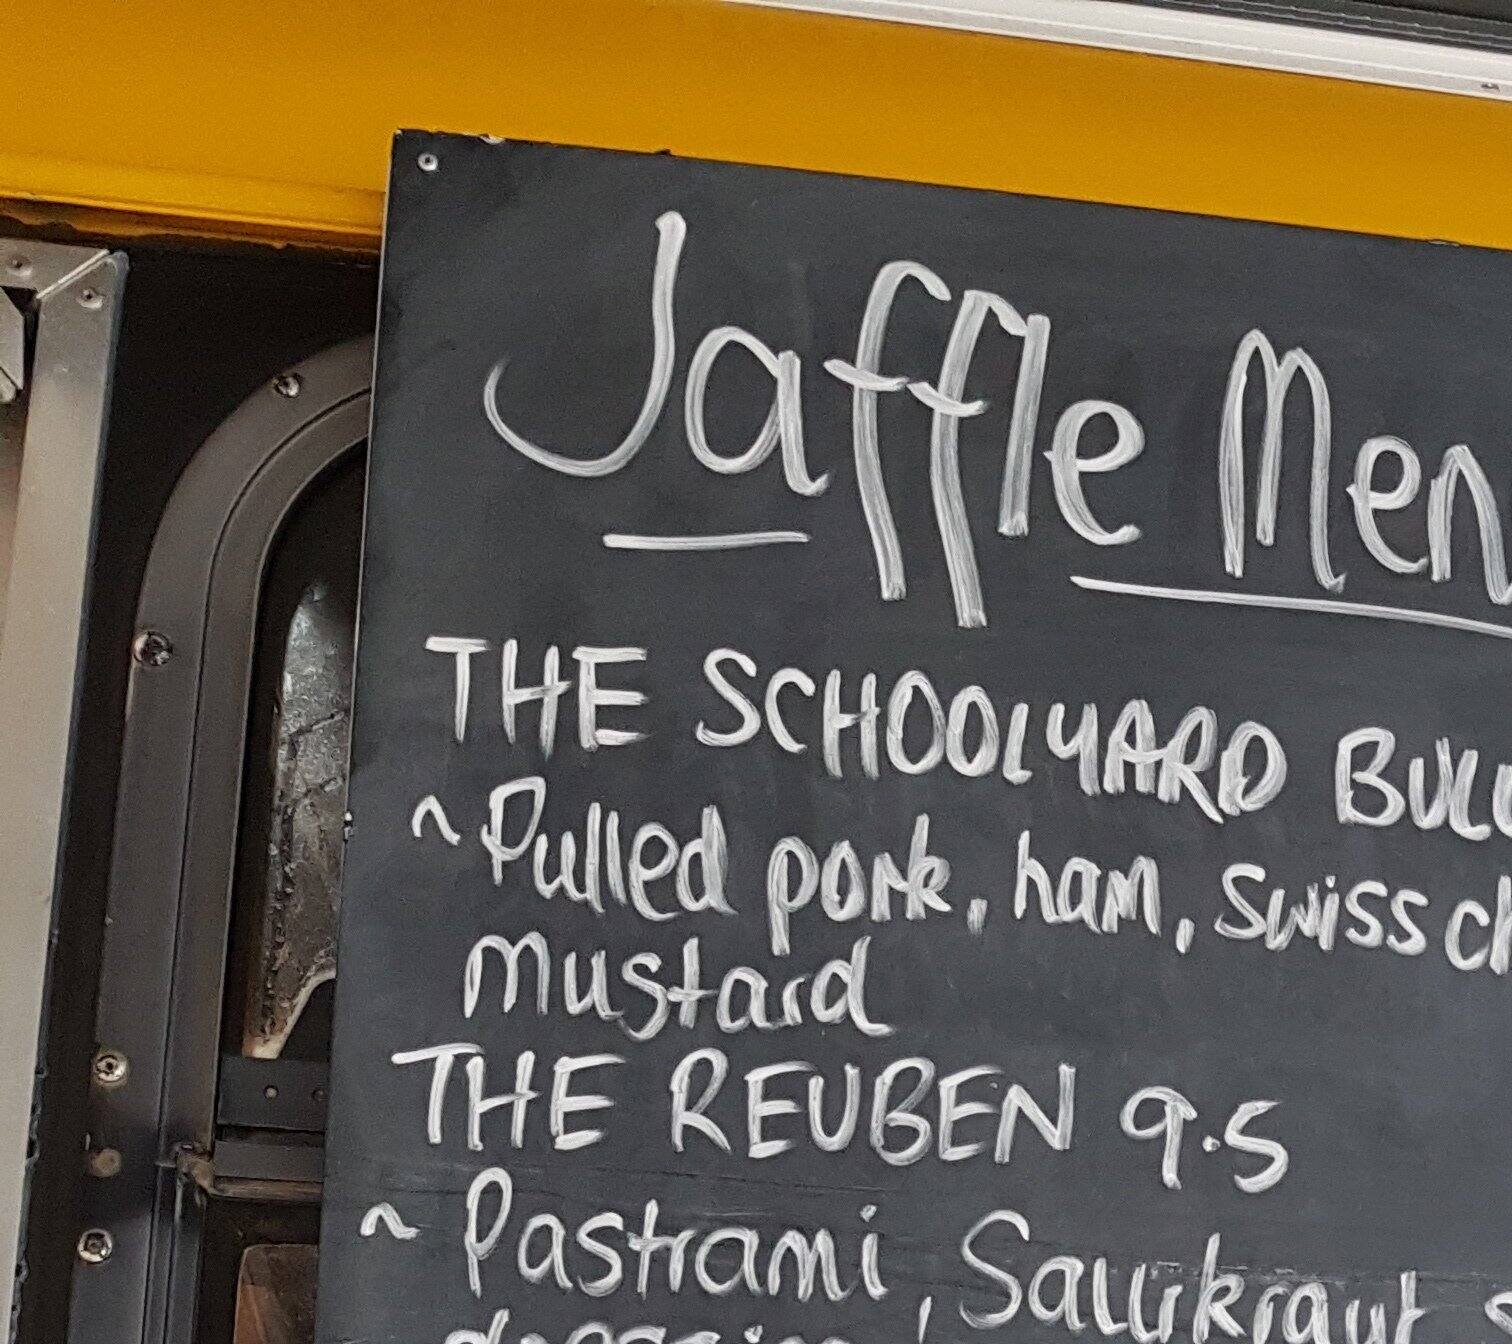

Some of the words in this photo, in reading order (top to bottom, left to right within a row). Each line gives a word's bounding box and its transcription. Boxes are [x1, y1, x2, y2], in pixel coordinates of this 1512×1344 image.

[481, 208, 1146, 631] Jaffle
[422, 633, 649, 758] THE
[693, 645, 1290, 826] SCHOOLYARD
[478, 773, 739, 924] Pulled
[388, 1040, 628, 1154] THE
[667, 1045, 1078, 1168] REUBEN
[1117, 1083, 1291, 1195] 9.5
